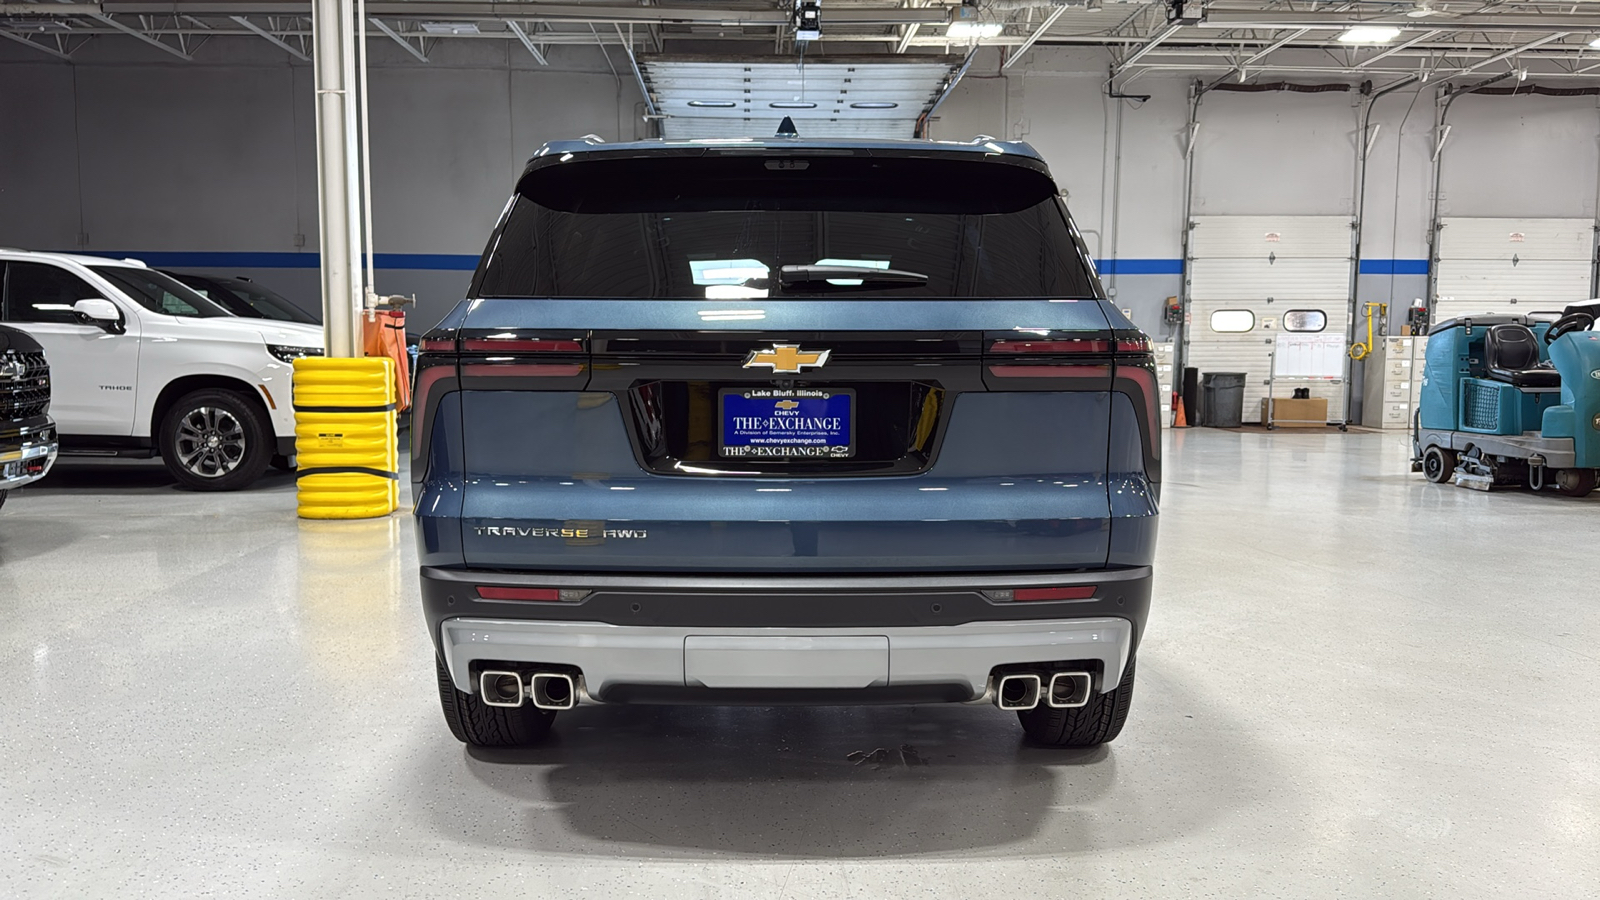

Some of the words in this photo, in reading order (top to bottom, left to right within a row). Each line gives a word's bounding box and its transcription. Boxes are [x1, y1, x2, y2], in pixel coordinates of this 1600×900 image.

[733, 417, 762, 430] THE
[769, 417, 841, 430] EXCHANGE
[750, 437, 826, 445] www.chevyexchange.com
[723, 447, 746, 456] THE
[758, 447, 824, 456] EXCHANGE
[474, 526, 589, 538] TRAVERSE
[602, 529, 647, 539] AWD
